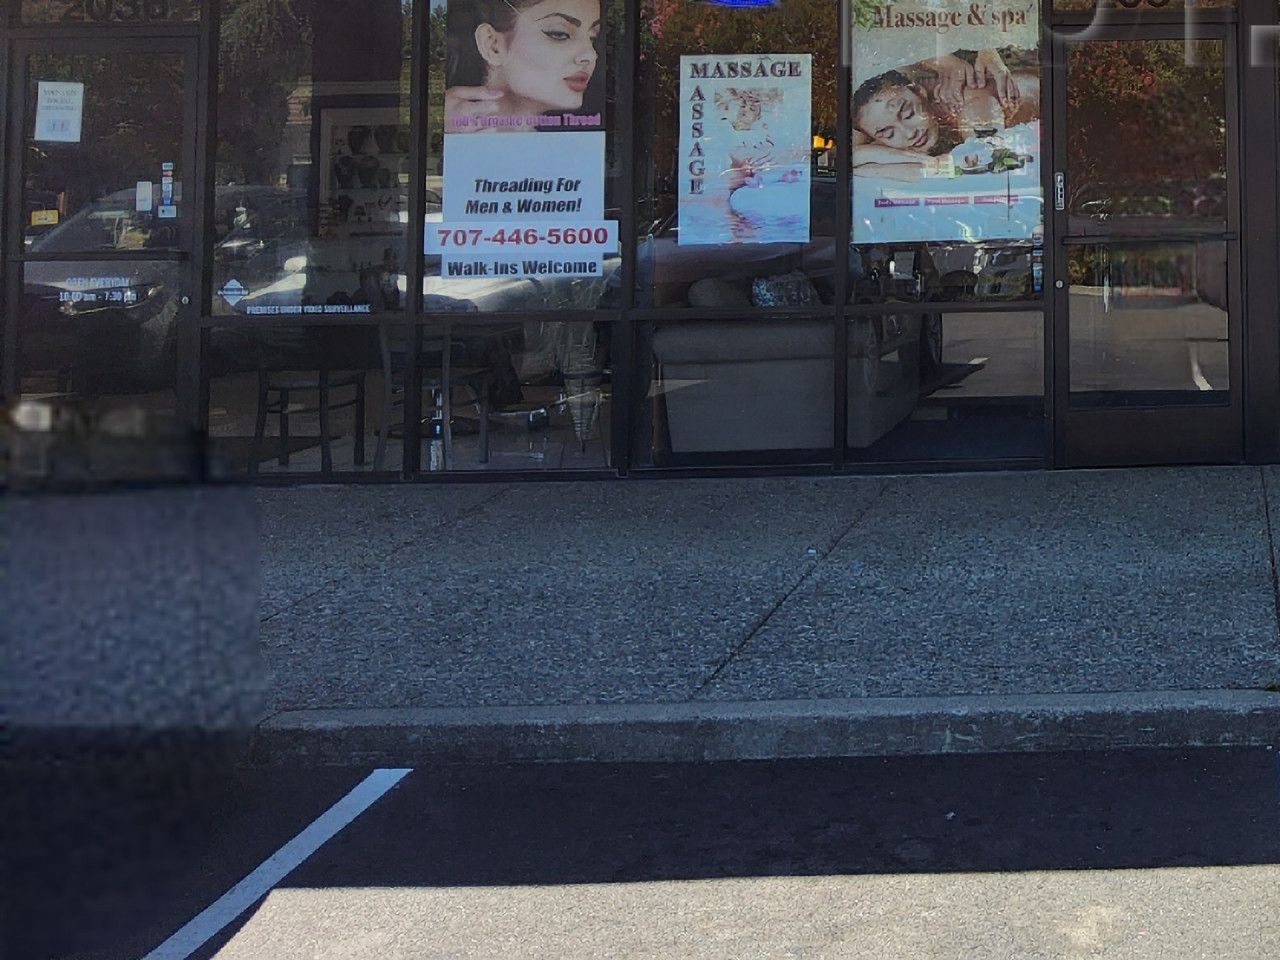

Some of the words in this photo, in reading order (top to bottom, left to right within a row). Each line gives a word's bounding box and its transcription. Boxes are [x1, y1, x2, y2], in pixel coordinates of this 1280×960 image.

[874, 4, 962, 34] Massage
[967, 2, 985, 26] &
[992, 7, 1026, 32] spa
[690, 60, 802, 79] MASSAGE
[475, 178, 553, 194] Threading
[556, 177, 581, 192] For
[465, 199, 499, 214] Men
[502, 200, 513, 214] &
[517, 198, 582, 214] Women!
[437, 227, 608, 246] 707-446-5600
[522, 260, 597, 275] Welcome
